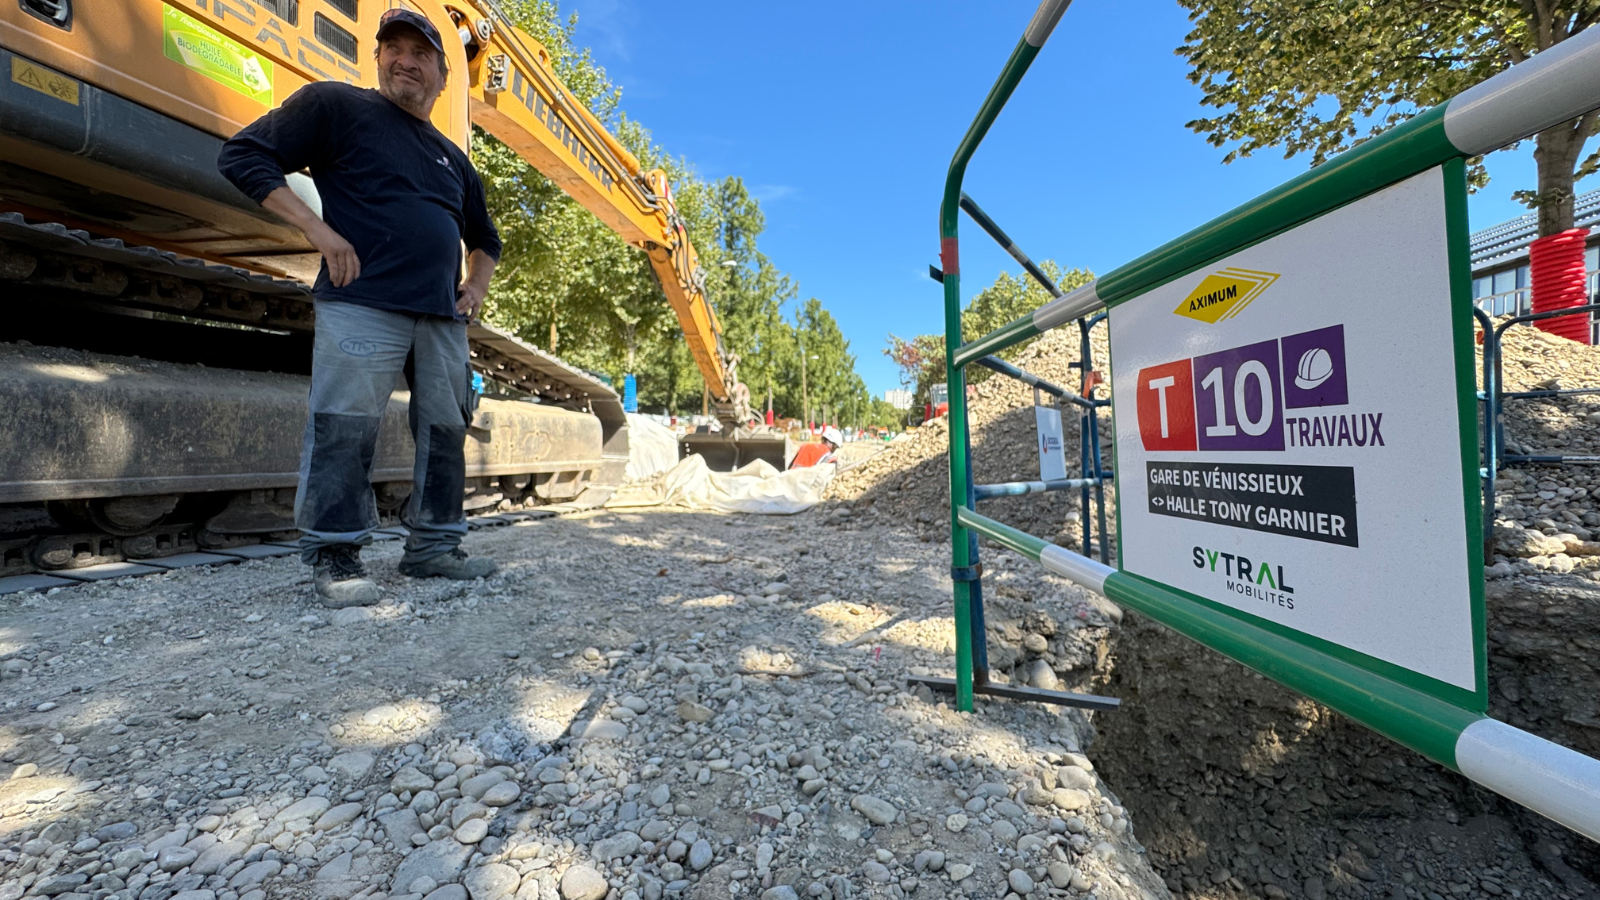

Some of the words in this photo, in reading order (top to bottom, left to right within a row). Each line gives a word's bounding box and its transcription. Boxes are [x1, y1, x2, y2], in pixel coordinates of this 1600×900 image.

[200, 41, 221, 57] HUILE
[512, 67, 613, 193] LIEBHERR
[1189, 285, 1237, 312] AXIMUM
[1286, 413, 1385, 447] TRAVAUX
[1150, 468, 1181, 486] GARE
[1183, 470, 1200, 487] DE
[1202, 466, 1304, 496] VÉNISSIEUX
[1166, 495, 1207, 516] HALLE
[1209, 500, 1251, 523] TONY
[1255, 505, 1346, 537] GARNIER
[1192, 546, 1294, 594] SYTRAL
[1226, 580, 1294, 610] MOBILITÉS
